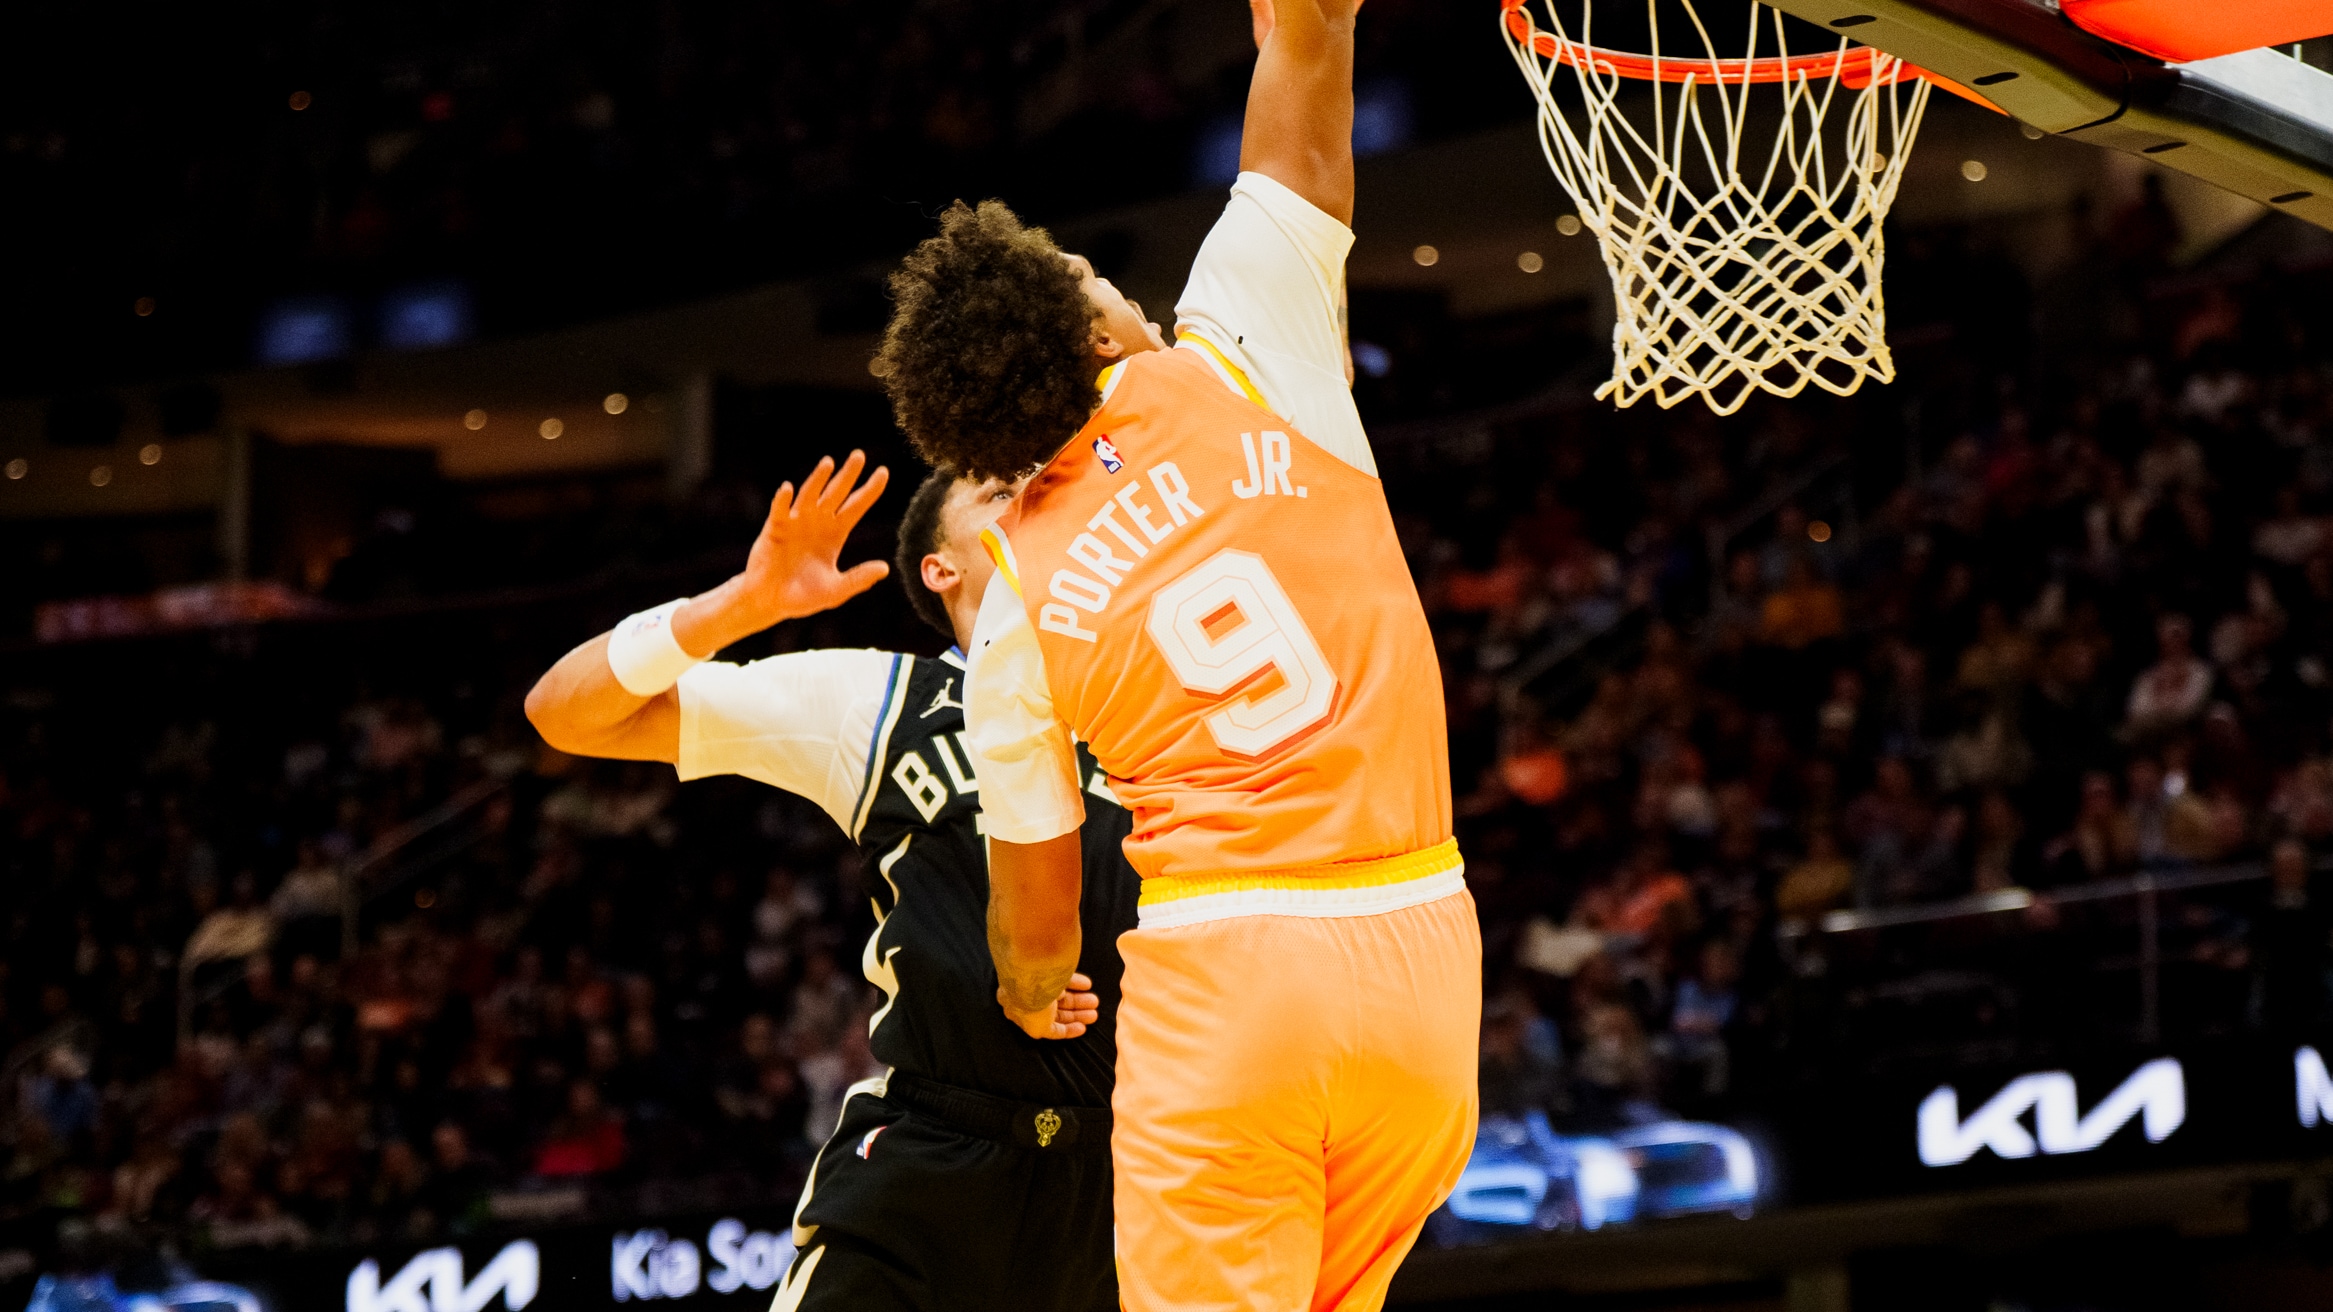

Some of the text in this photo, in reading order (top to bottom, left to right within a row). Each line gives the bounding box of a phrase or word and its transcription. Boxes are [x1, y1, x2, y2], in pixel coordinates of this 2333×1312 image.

[1039, 431, 1307, 643] PORTER JR.
[1145, 547, 1342, 764] 9
